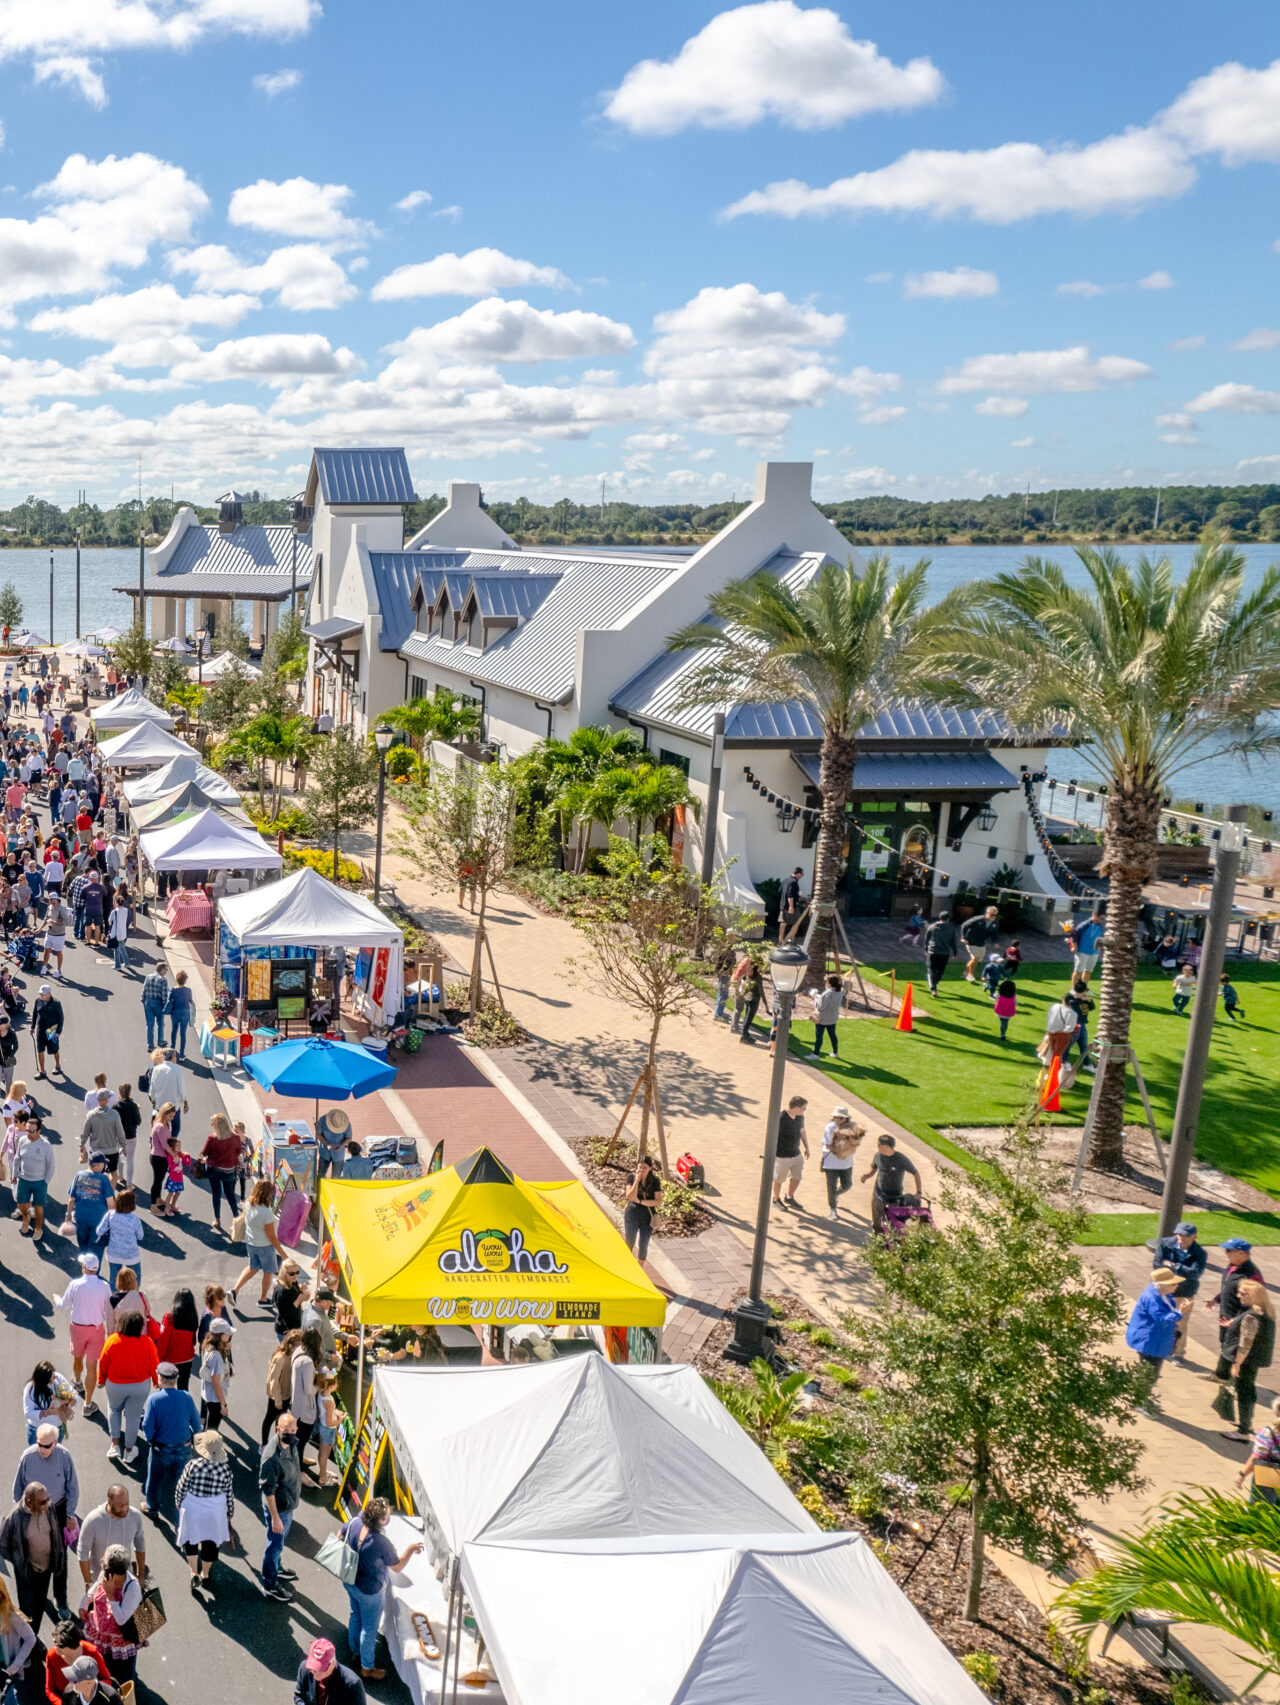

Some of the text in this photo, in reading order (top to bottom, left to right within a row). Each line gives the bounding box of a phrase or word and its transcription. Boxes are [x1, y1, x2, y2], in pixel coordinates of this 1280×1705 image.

[444, 1275, 571, 1284] HANDCRAFTED LEMONADES
[558, 1302, 598, 1312] LEMONADE
[563, 1311, 593, 1319] STAND
